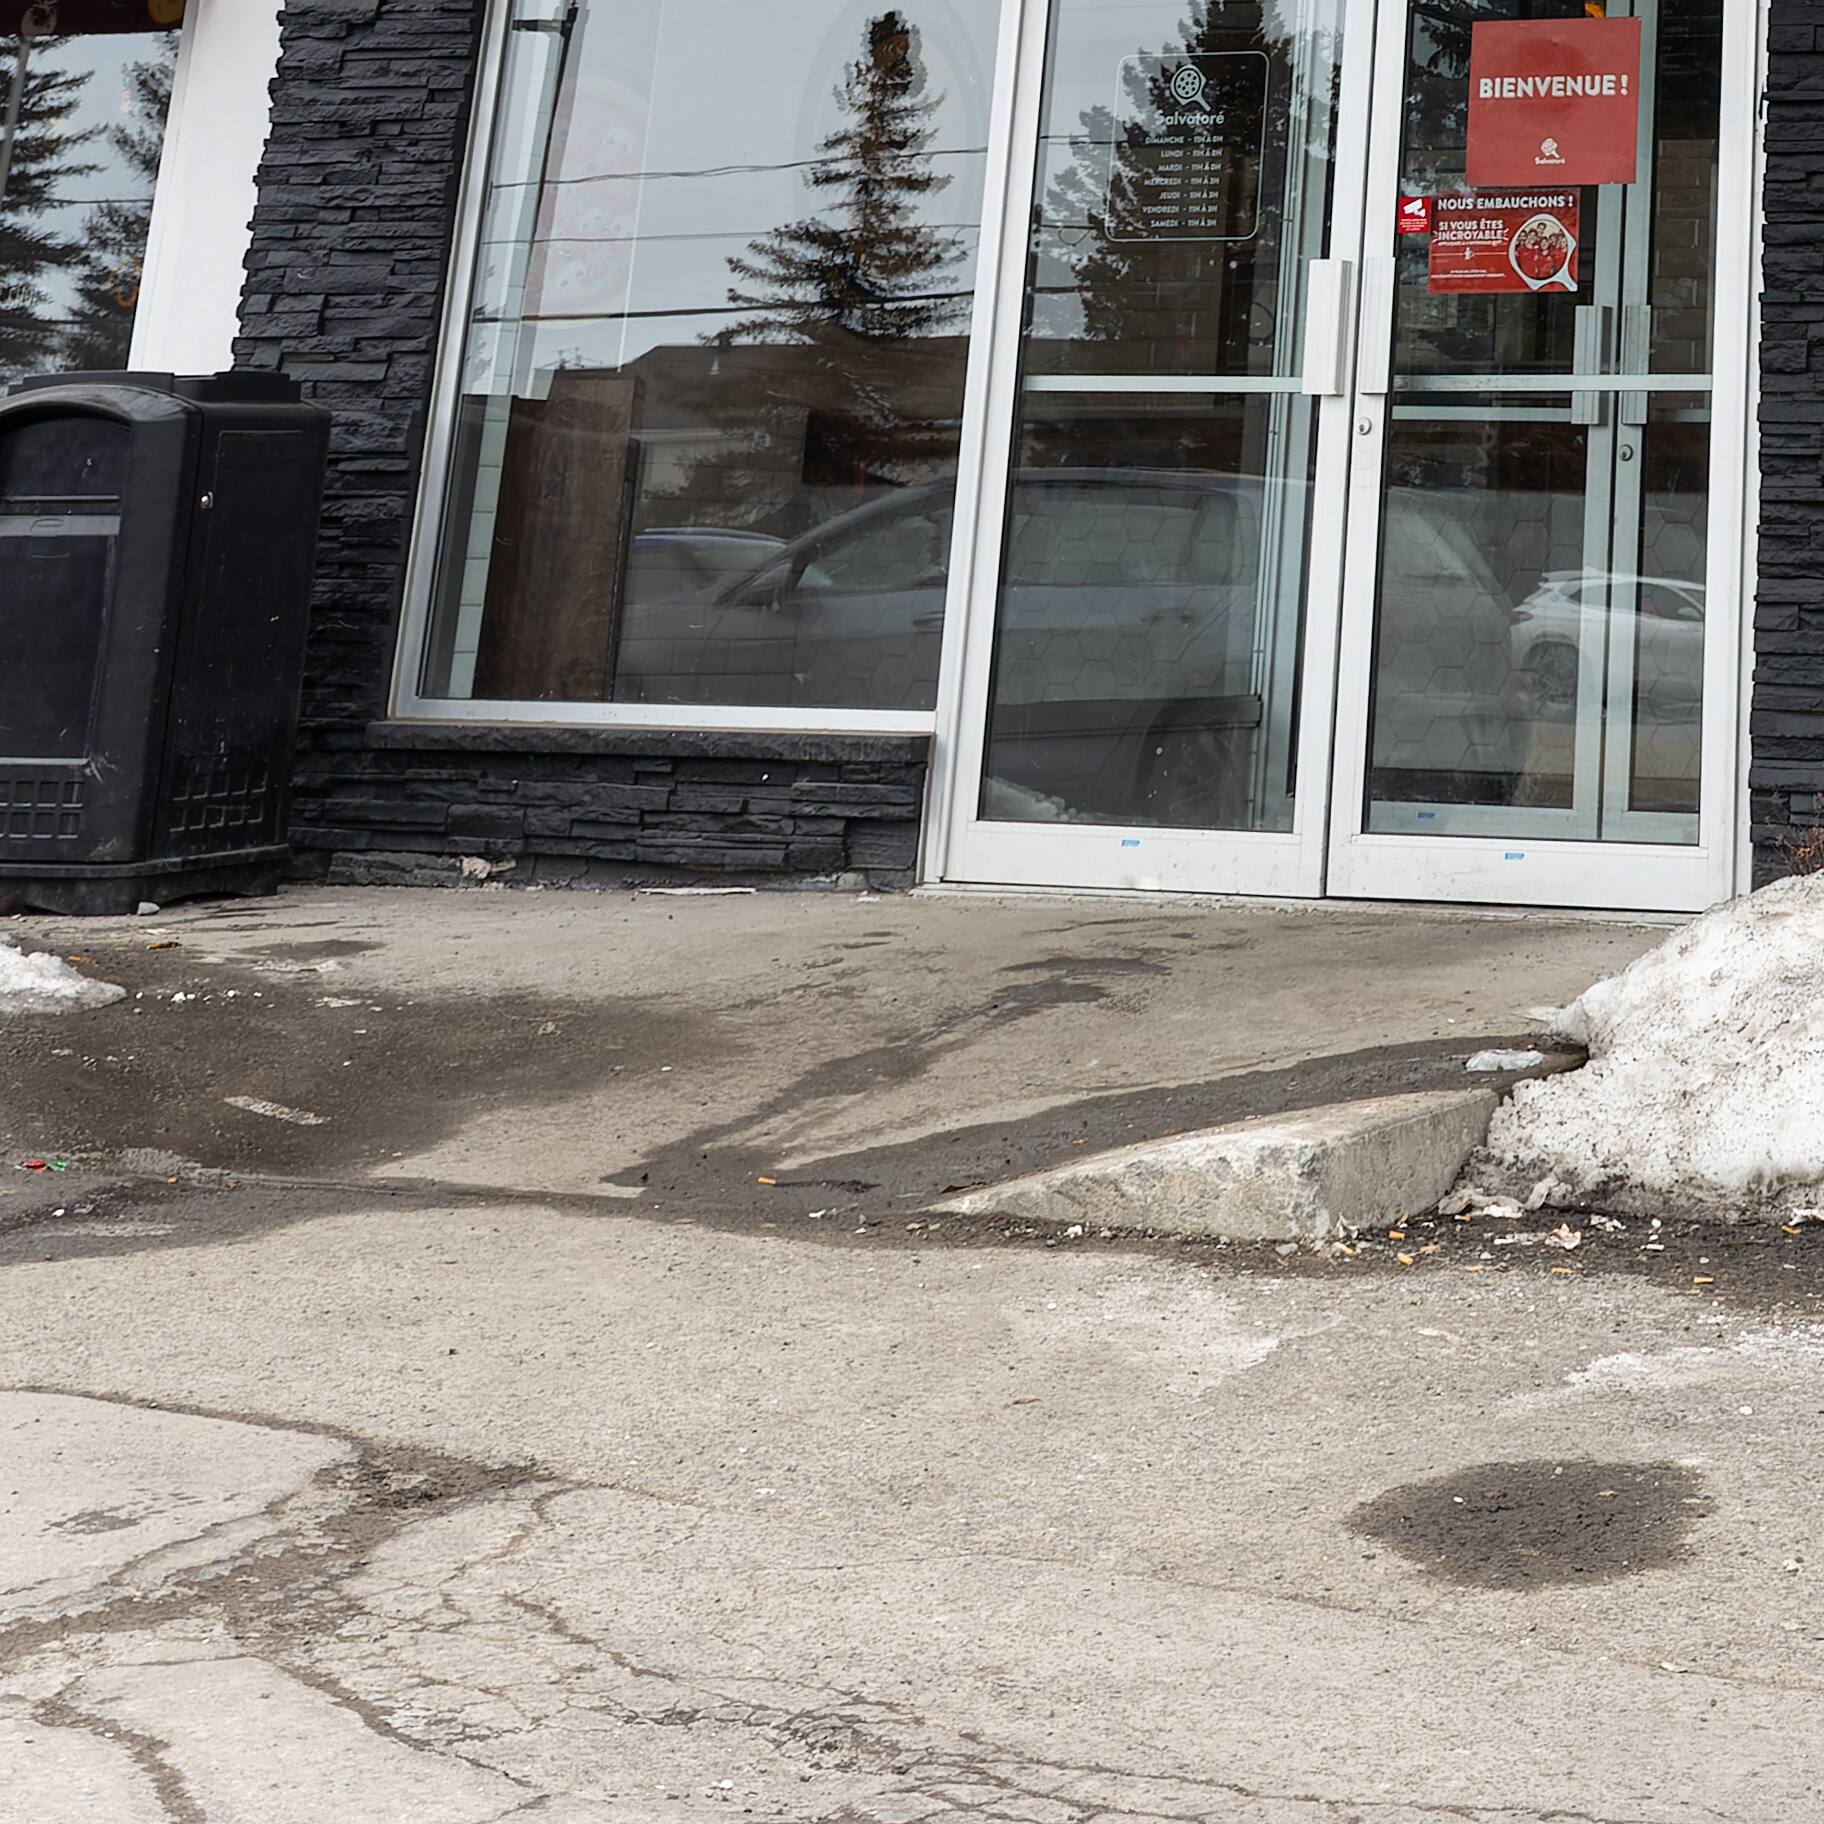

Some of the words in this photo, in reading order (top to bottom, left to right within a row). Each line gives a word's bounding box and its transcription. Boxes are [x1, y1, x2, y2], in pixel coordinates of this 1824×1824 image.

[1153, 109, 1225, 126] Salvatoré
[1438, 198, 1473, 210] NOUS
[1438, 221, 1448, 230] SI
[1450, 220, 1478, 230] VOUS
[1480, 218, 1503, 230] ÊTES
[1438, 230, 1503, 241] INCROYABLE
